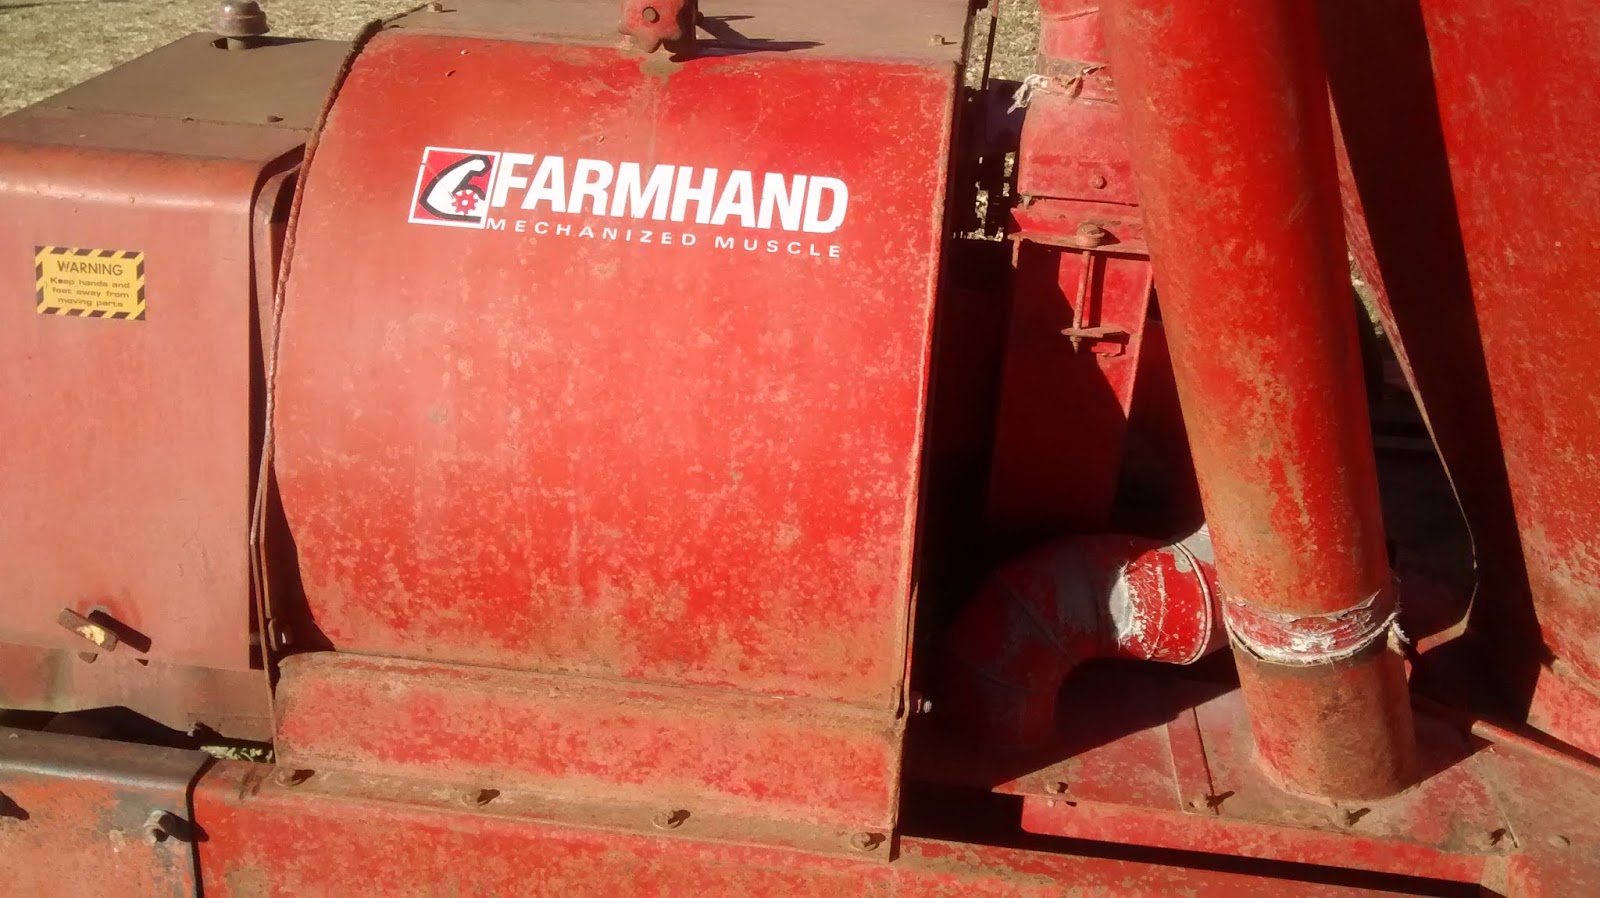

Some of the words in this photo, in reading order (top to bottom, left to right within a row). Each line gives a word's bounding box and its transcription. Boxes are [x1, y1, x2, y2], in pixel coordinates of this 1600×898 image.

[492, 152, 848, 234] FARMHAND
[486, 217, 697, 247] MECHANIZED
[714, 236, 841, 258] MUSCLE
[57, 260, 123, 276] WARNING
[50, 277, 75, 286] Keep
[78, 278, 108, 287] hands
[112, 281, 130, 289] and
[52, 286, 72, 294] feet
[76, 289, 101, 297] away
[106, 290, 129, 298] from
[57, 298, 93, 307] moving
[96, 300, 123, 308] parts
